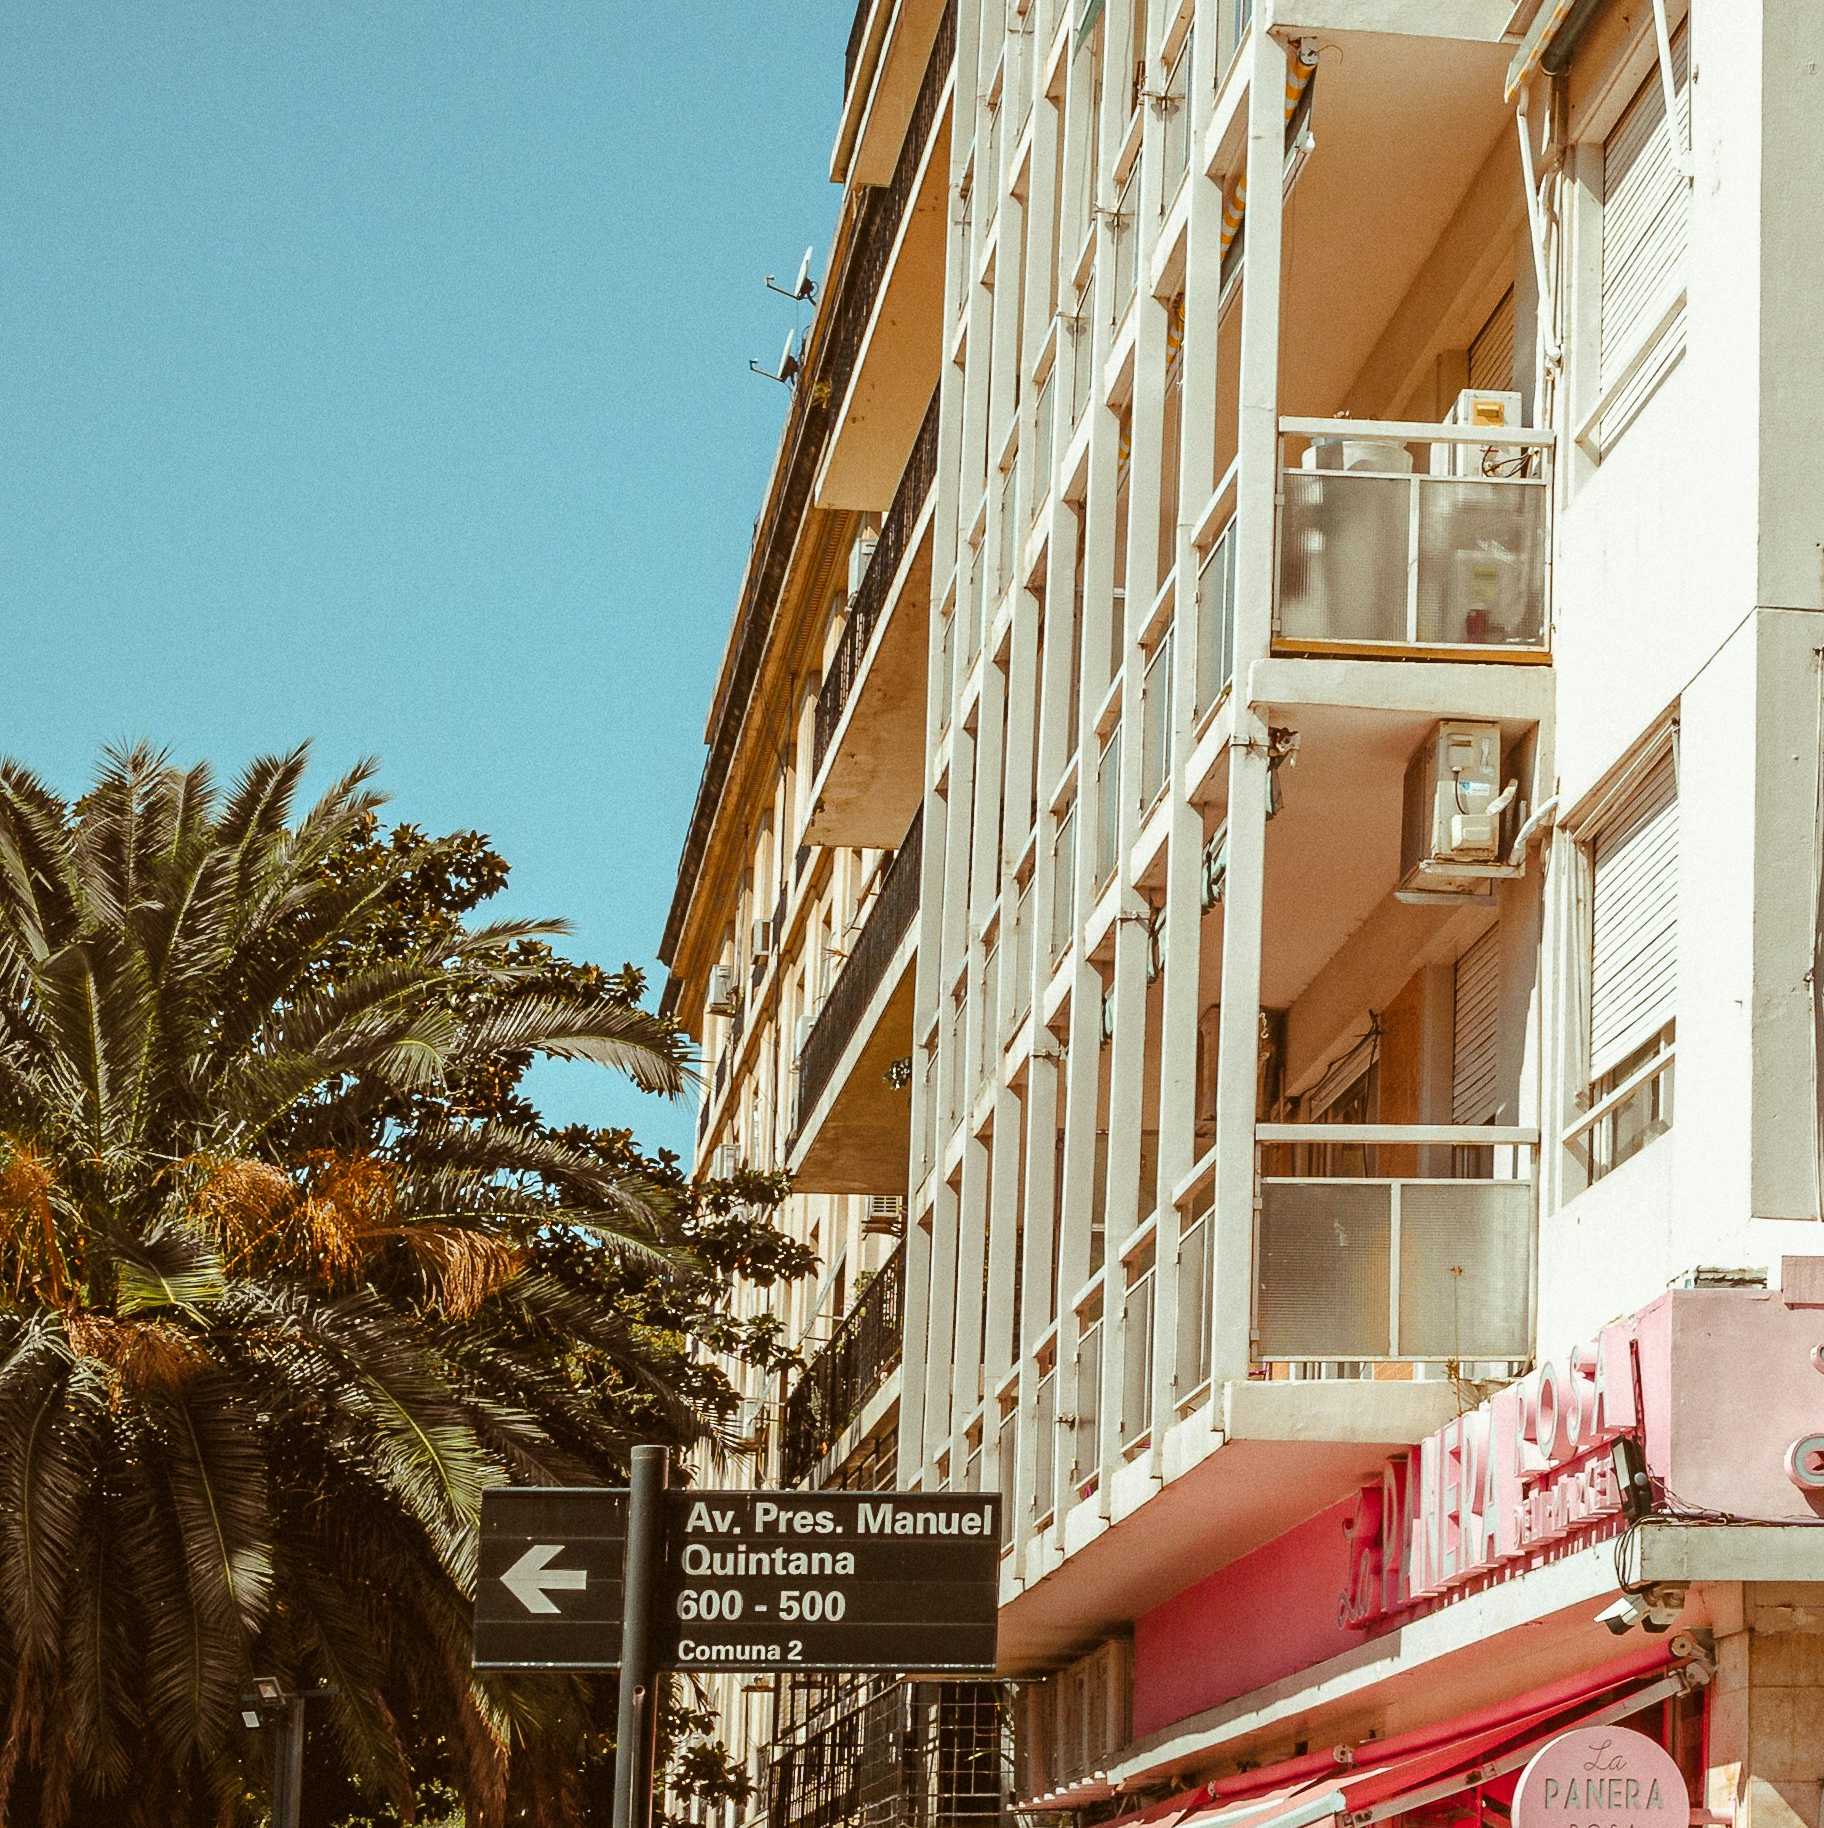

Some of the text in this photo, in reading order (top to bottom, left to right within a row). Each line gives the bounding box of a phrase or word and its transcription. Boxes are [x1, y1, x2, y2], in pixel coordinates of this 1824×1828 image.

[1381, 1395, 1518, 1613] PANERA
[1514, 1326, 1628, 1479] ROSA
[684, 1501, 994, 1537] Av. Pres. Manuel
[681, 1543, 856, 1577] Quintana
[676, 1589, 744, 1621] 600
[777, 1589, 846, 1622] 500
[677, 1639, 803, 1662] Comuna 2
[1583, 1738, 1628, 1772] La
[1543, 1777, 1666, 1810] PANERA
